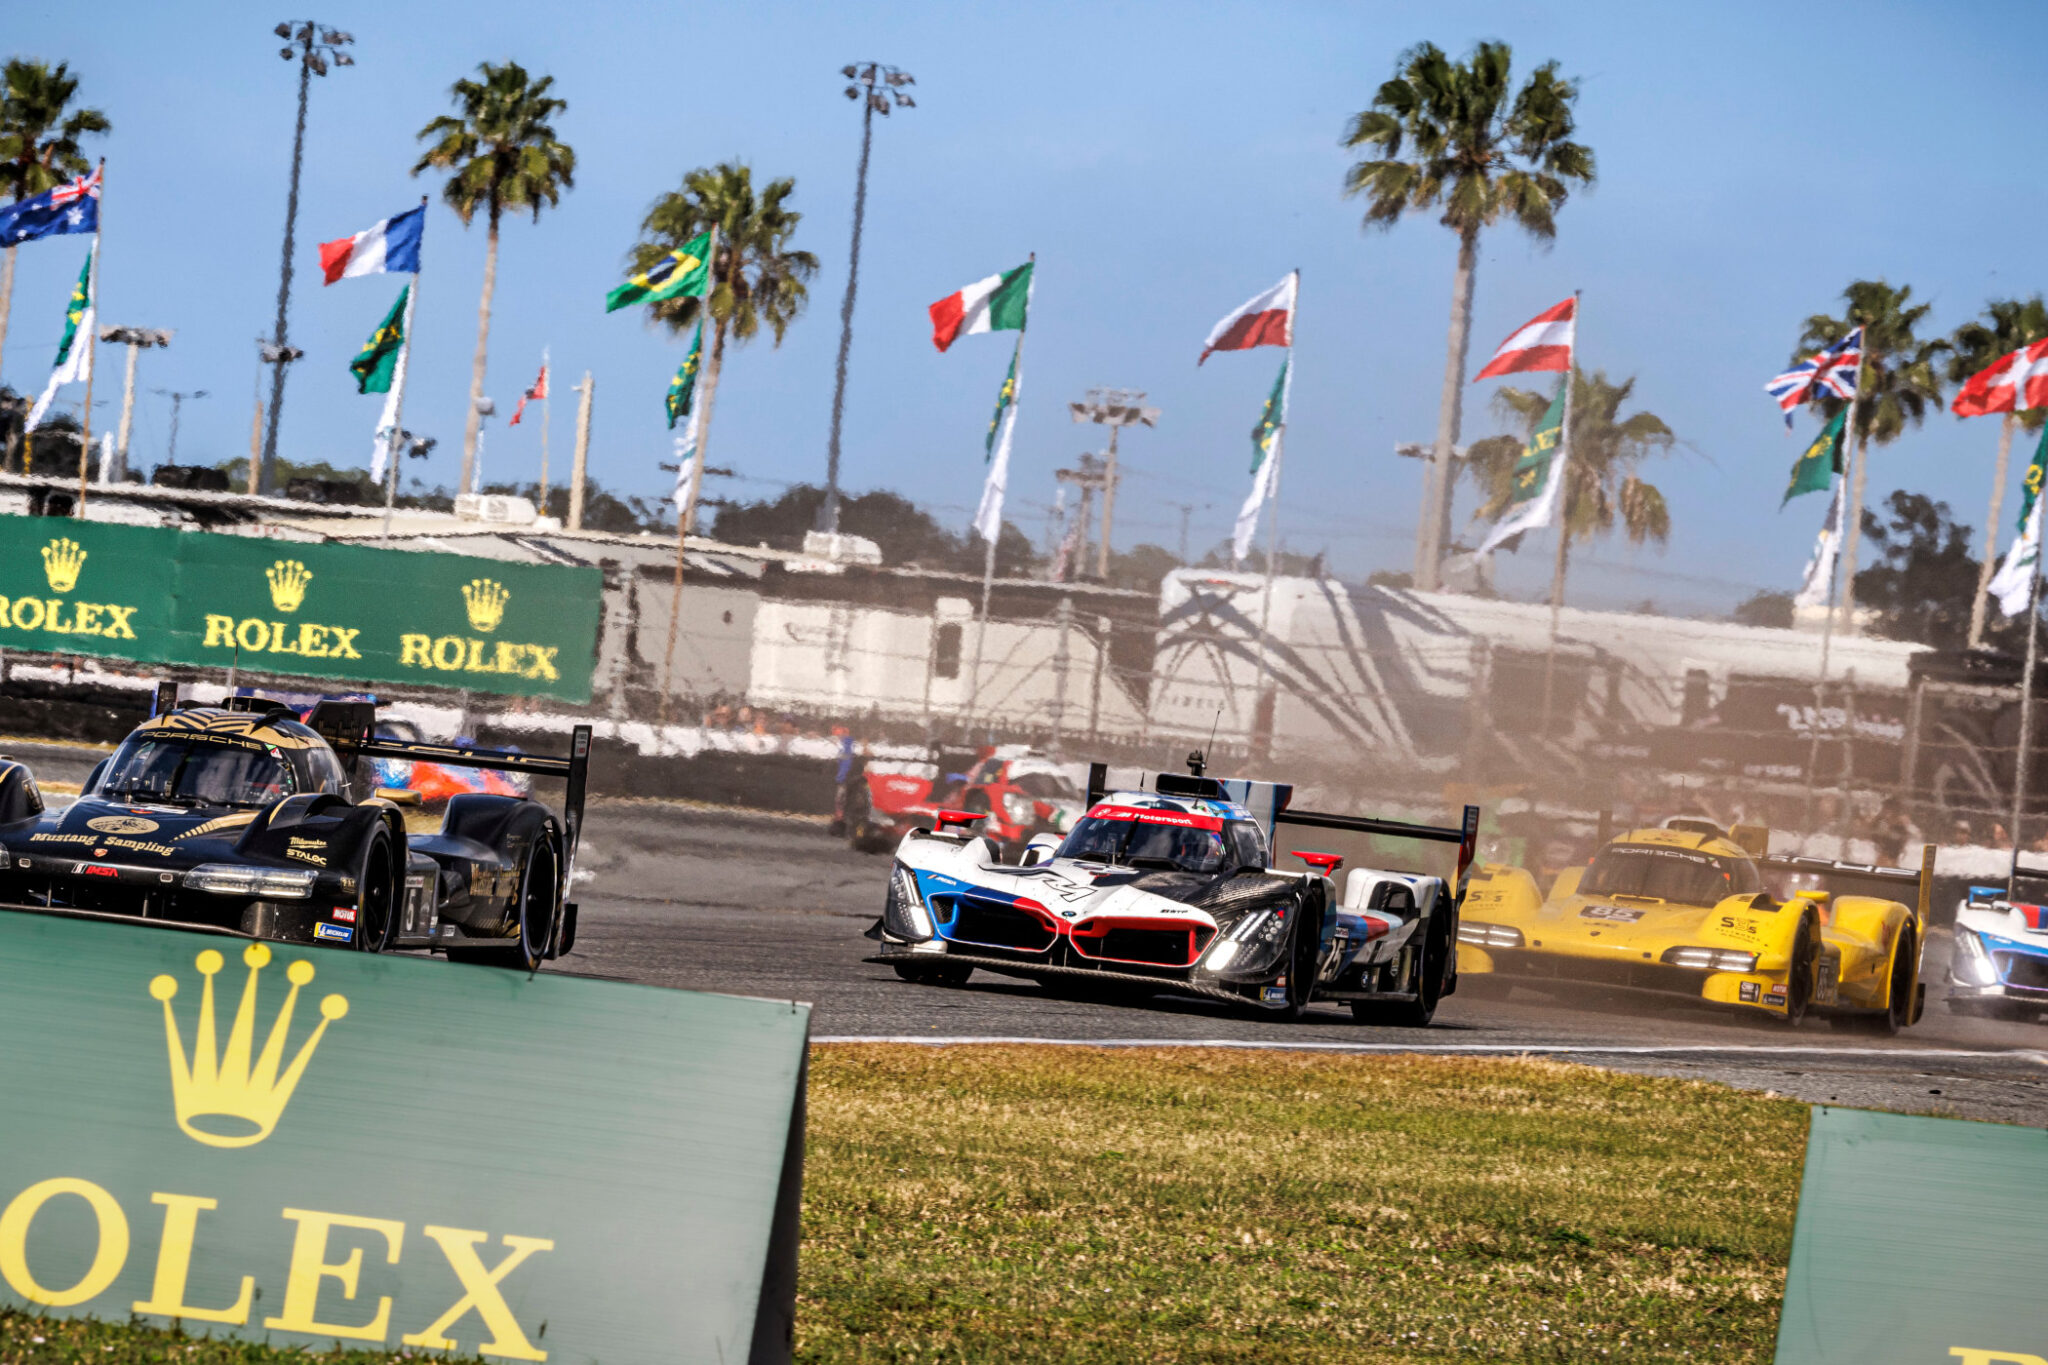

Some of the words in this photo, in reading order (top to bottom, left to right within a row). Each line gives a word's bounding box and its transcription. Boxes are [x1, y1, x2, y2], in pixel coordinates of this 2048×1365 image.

[202, 613, 362, 660] ROLEX
[398, 633, 561, 683] ROLEX
[140, 731, 262, 750] PORSCHE
[1134, 812, 1193, 826] Motorsport
[29, 832, 100, 845] Mustang
[104, 836, 176, 857] Sampling
[286, 848, 328, 866] STALOC
[1611, 847, 1707, 864] PORSCHE
[85, 865, 119, 878] IMSA
[333, 908, 355, 921] MOTUL
[1590, 905, 1635, 918] 85
